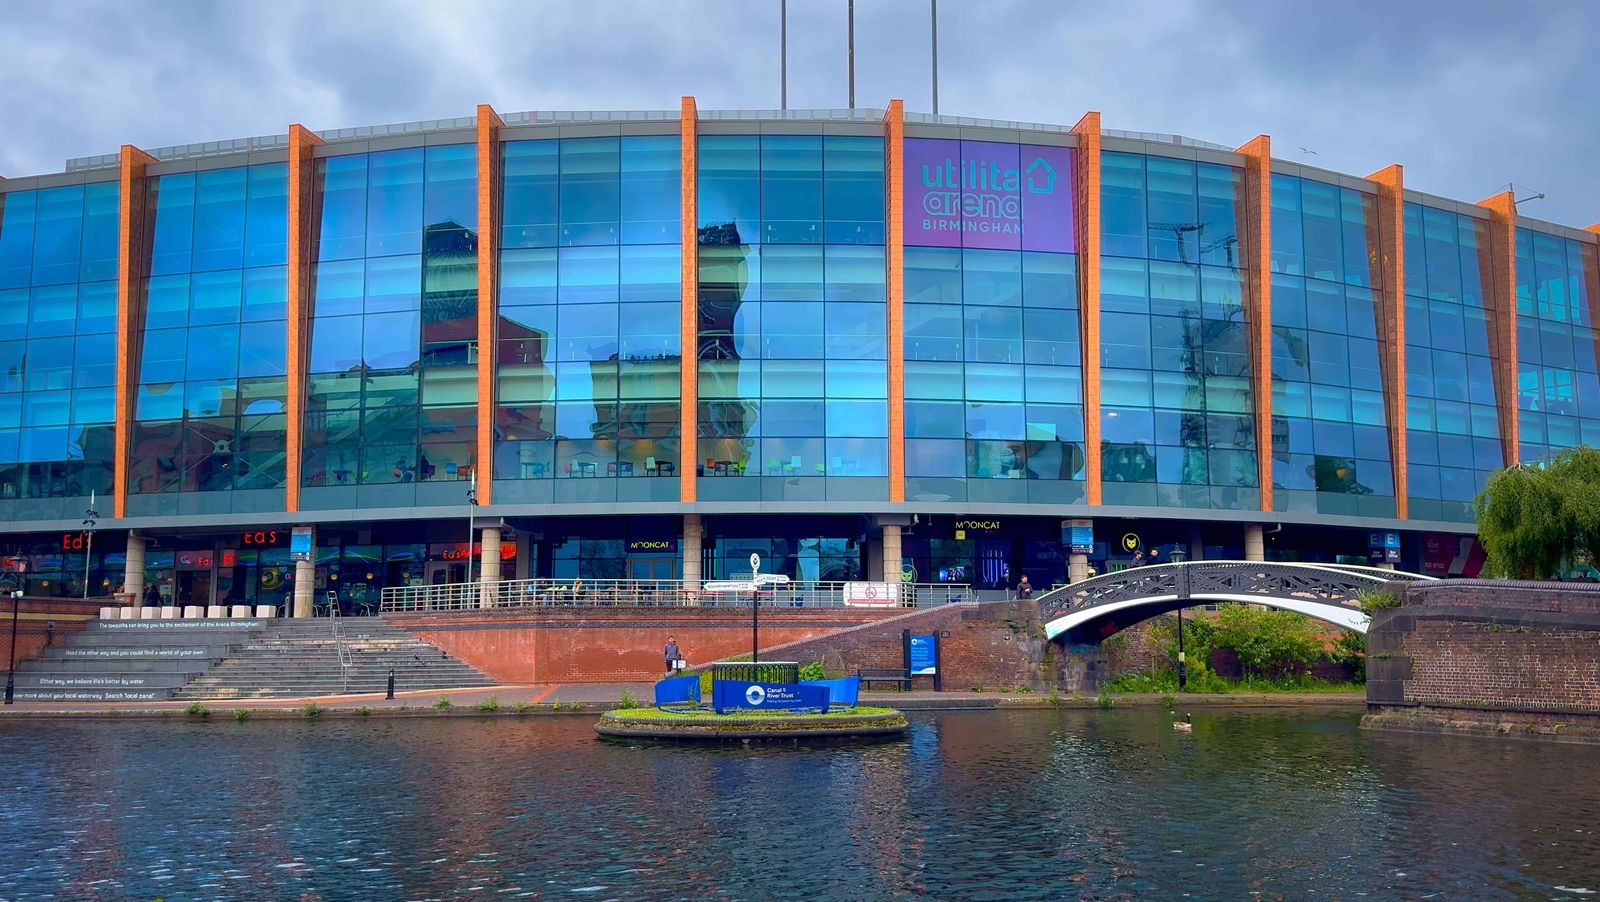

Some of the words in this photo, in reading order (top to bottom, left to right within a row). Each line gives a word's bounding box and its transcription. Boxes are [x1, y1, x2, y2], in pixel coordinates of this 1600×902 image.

[922, 159, 1023, 191] utilita
[923, 191, 1024, 219] arena
[922, 219, 1024, 234] BIRMINGHAM
